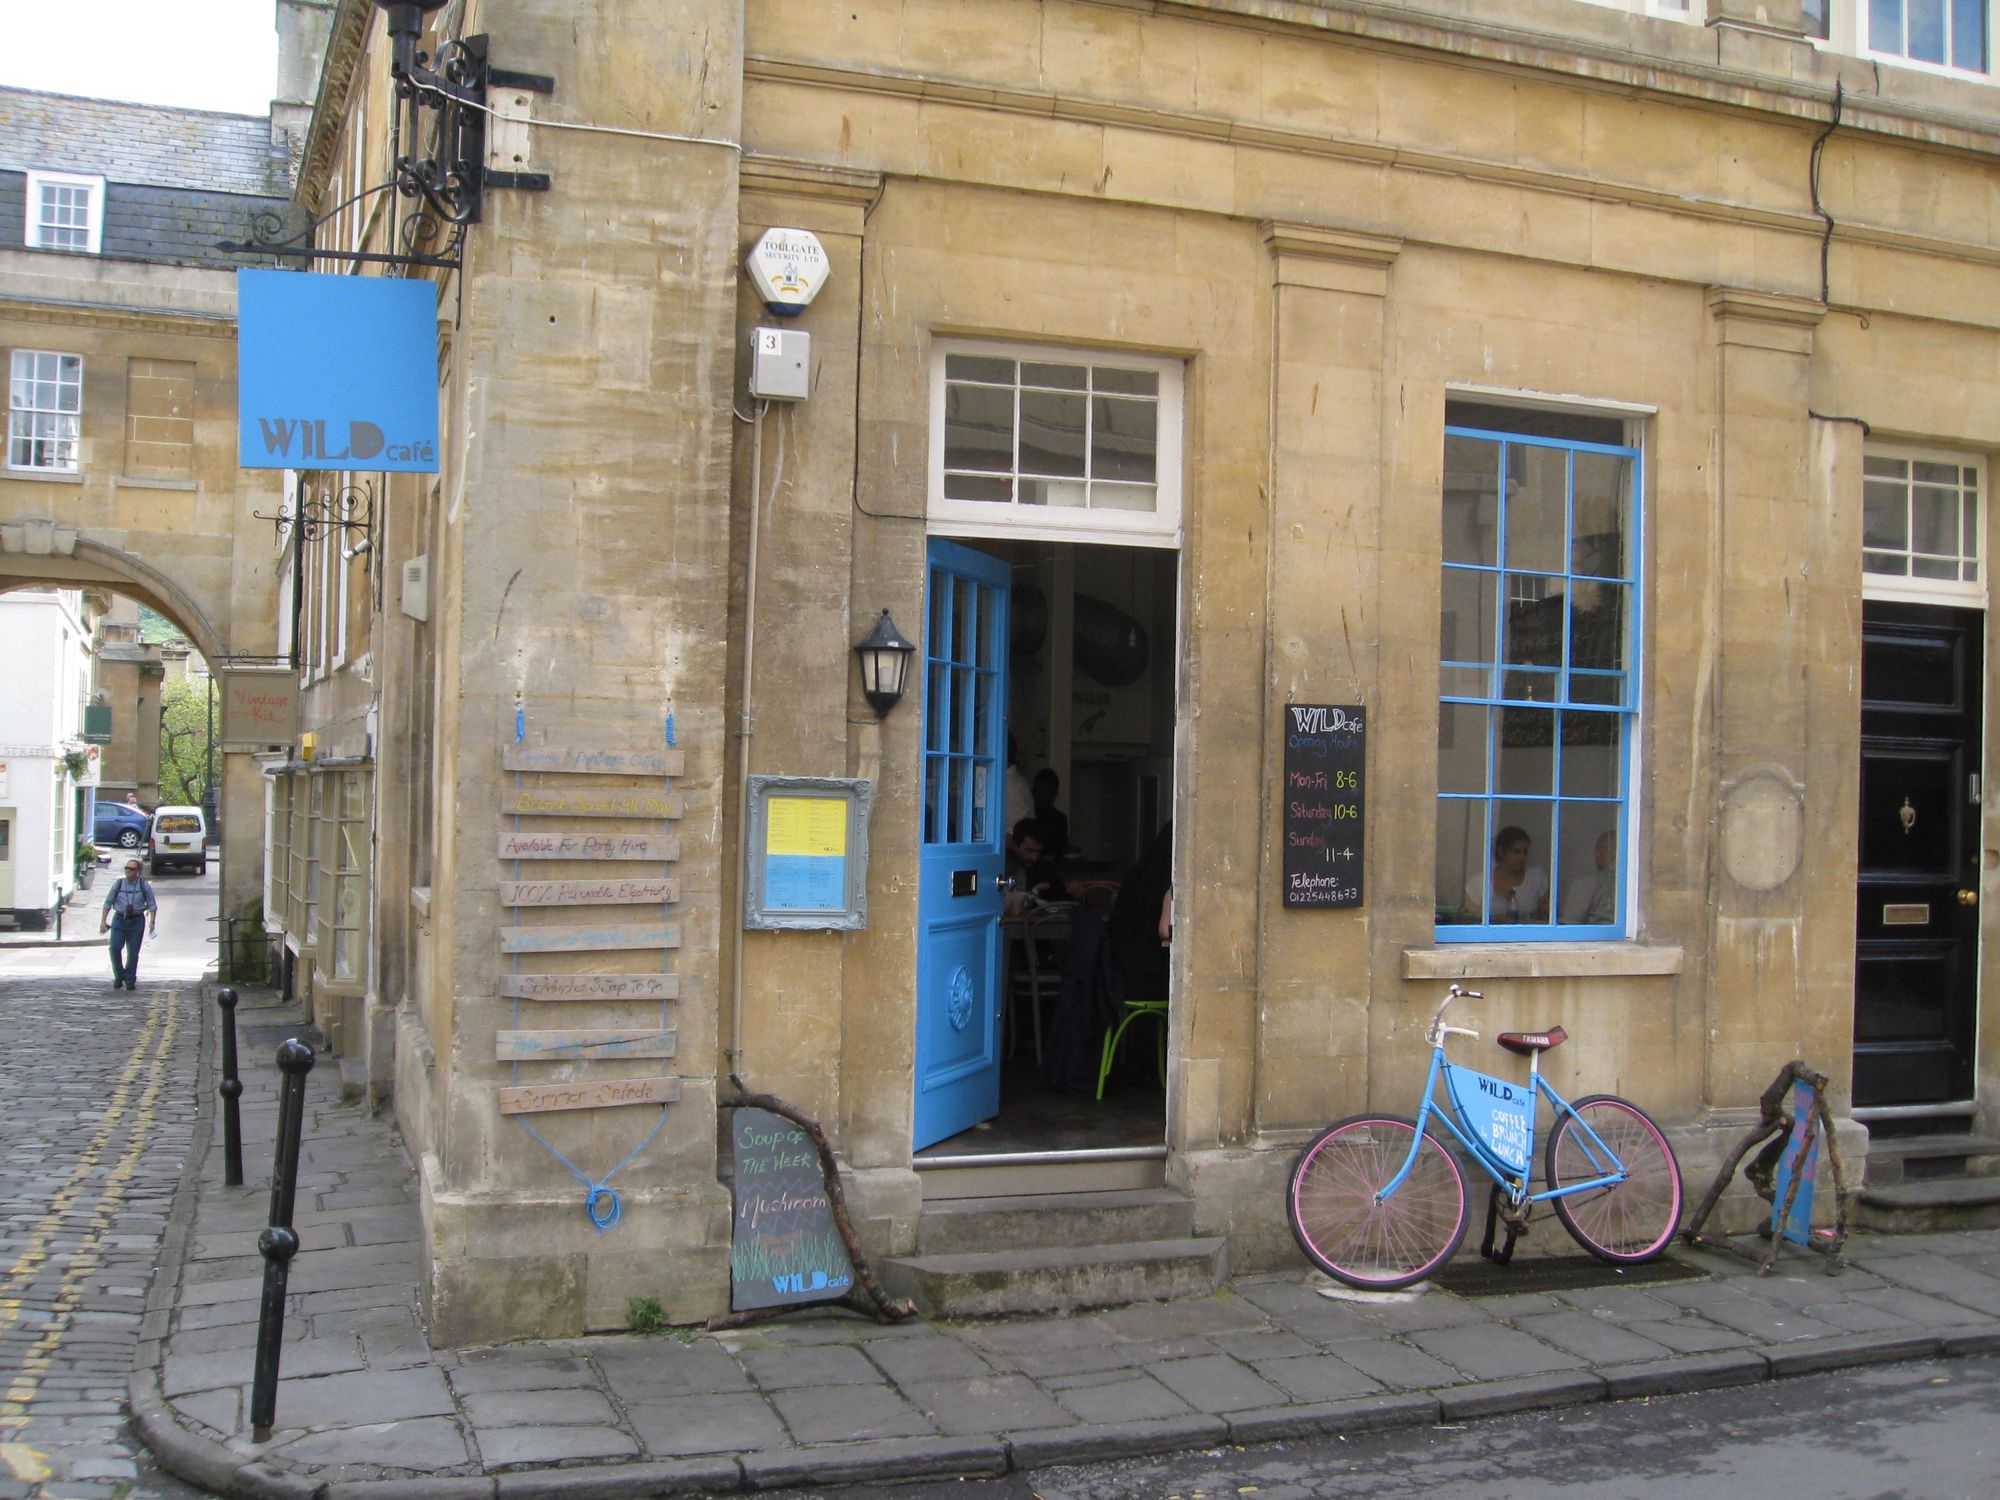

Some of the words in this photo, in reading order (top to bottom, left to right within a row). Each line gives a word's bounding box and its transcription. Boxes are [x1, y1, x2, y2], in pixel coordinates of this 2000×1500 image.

[763, 241, 820, 255] TOLLGATE
[764, 252, 800, 261] SECURITY
[804, 255, 820, 263] LTD
[766, 335, 776, 350] 3
[258, 418, 385, 460] WILD
[386, 440, 434, 462] café
[234, 688, 289, 707] Vintage
[1290, 707, 1346, 733] WILD
[4, 747, 49, 756] STREET
[1289, 734, 1327, 757] Opening
[1289, 771, 1327, 791] Mon-Fri
[1336, 770, 1357, 788] 8-6
[648, 799, 673, 816] Day
[1291, 802, 1332, 827] Saturday
[1334, 804, 1358, 820] 10-6
[506, 837, 553, 853] Available
[559, 838, 577, 851] For
[583, 836, 615, 858] Party
[620, 838, 647, 853] Hire
[1289, 831, 1326, 850] Sunday
[1326, 847, 1354, 863] 11-4
[511, 884, 552, 902] 100%
[558, 883, 613, 900] Renewable
[618, 883, 671, 901] Electricity
[602, 979, 627, 996] Soup
[648, 979, 664, 993] Go
[516, 1090, 586, 1110] Summer
[596, 1083, 653, 1104] Salads
[1478, 1077, 1513, 1101] WILD
[1491, 1109, 1526, 1134] COFFEE
[738, 1126, 785, 1152] Soup
[1492, 1123, 1527, 1151] BRUNCH
[743, 1157, 768, 1175] THE
[773, 1151, 812, 1172] WEEK
[1491, 1139, 1524, 1165] LUNCH
[740, 1191, 826, 1229] Mushroom
[771, 1271, 829, 1294] WILD
[827, 1275, 849, 1287] café
